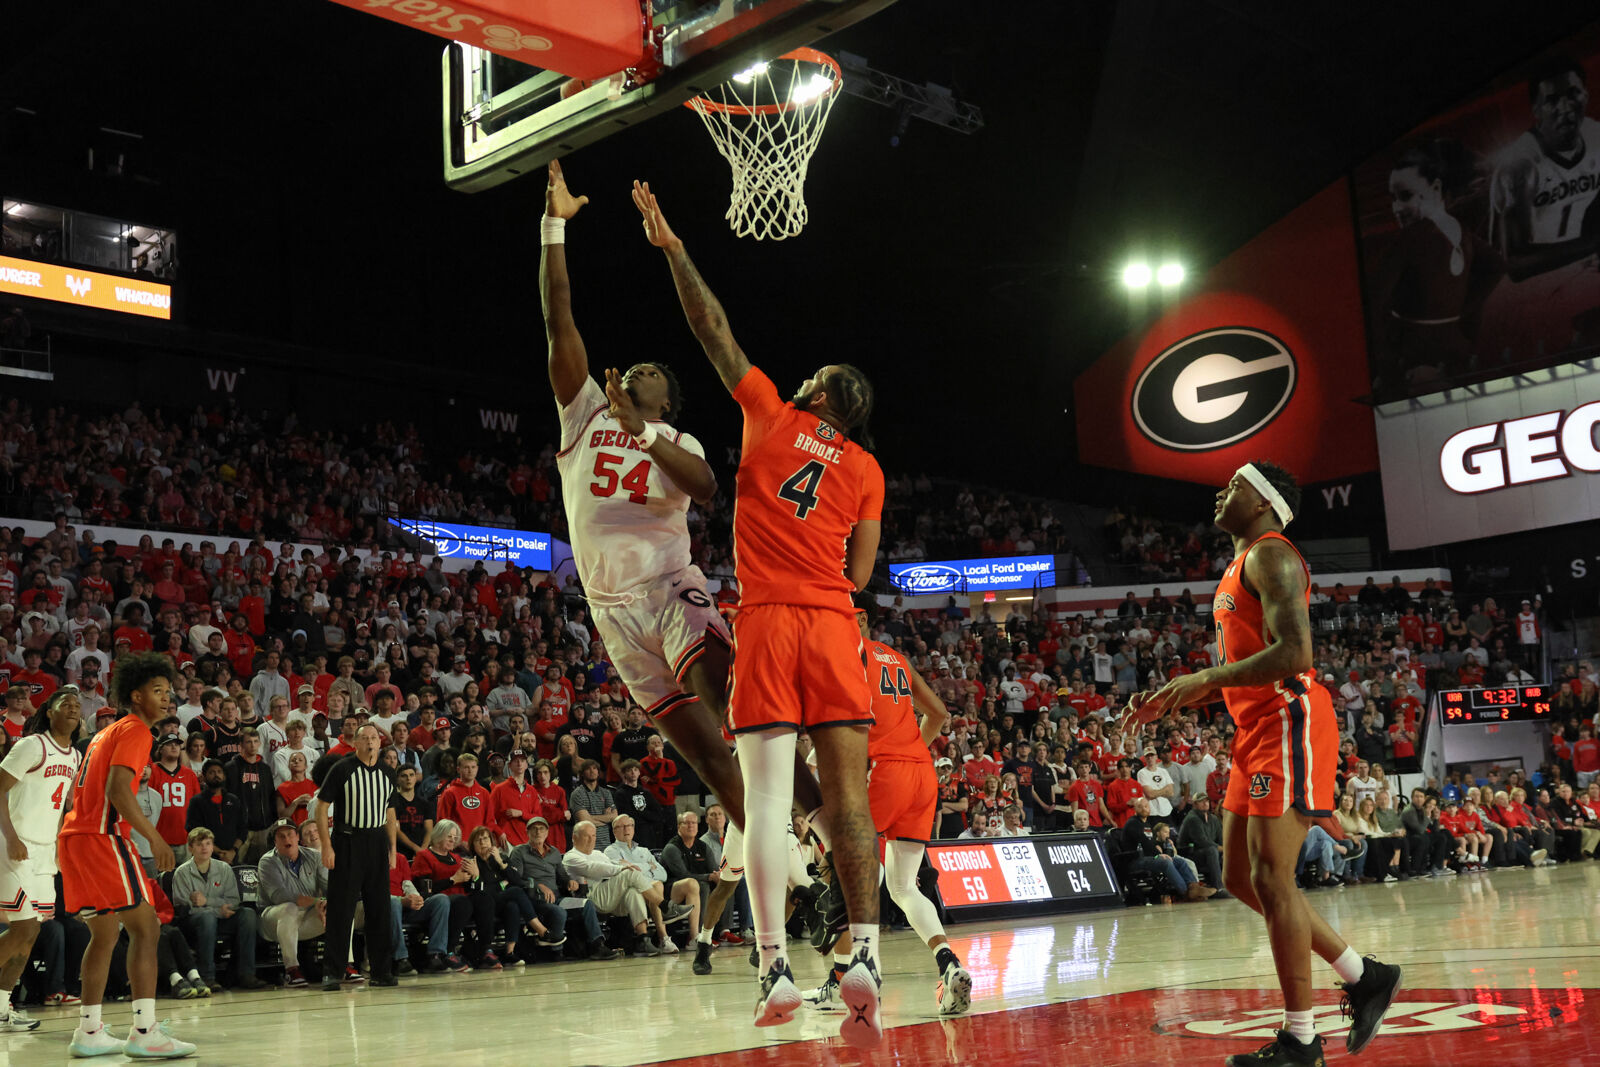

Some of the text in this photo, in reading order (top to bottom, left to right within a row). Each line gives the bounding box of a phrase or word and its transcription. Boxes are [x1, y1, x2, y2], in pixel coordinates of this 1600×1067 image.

[0, 266, 42, 287] URGER
[115, 287, 170, 309] WHATABU
[480, 409, 518, 432] WW
[794, 432, 844, 464] BROOME
[590, 452, 651, 505] 54
[777, 459, 827, 520] 4
[1322, 484, 1352, 509] YY
[464, 532, 548, 551] Local Ford Dealer
[464, 545, 488, 556] Proud
[907, 568, 949, 586] Ford
[963, 561, 1050, 576] Local Ford Dealer
[989, 574, 1022, 585] Sponsor
[879, 664, 914, 706] 44
[1483, 689, 1516, 704] 9:32
[552, 707, 563, 716] 24
[1446, 707, 1462, 719] 59
[1501, 708, 1509, 720] 2
[1534, 702, 1550, 714] 64
[51, 782, 65, 810] 4
[162, 782, 186, 808] 19
[938, 850, 992, 872] GEORGIA
[1002, 845, 1031, 860] 9:32
[1047, 844, 1093, 865] AUBURN
[962, 876, 989, 901] 59
[1067, 869, 1091, 893] 64
